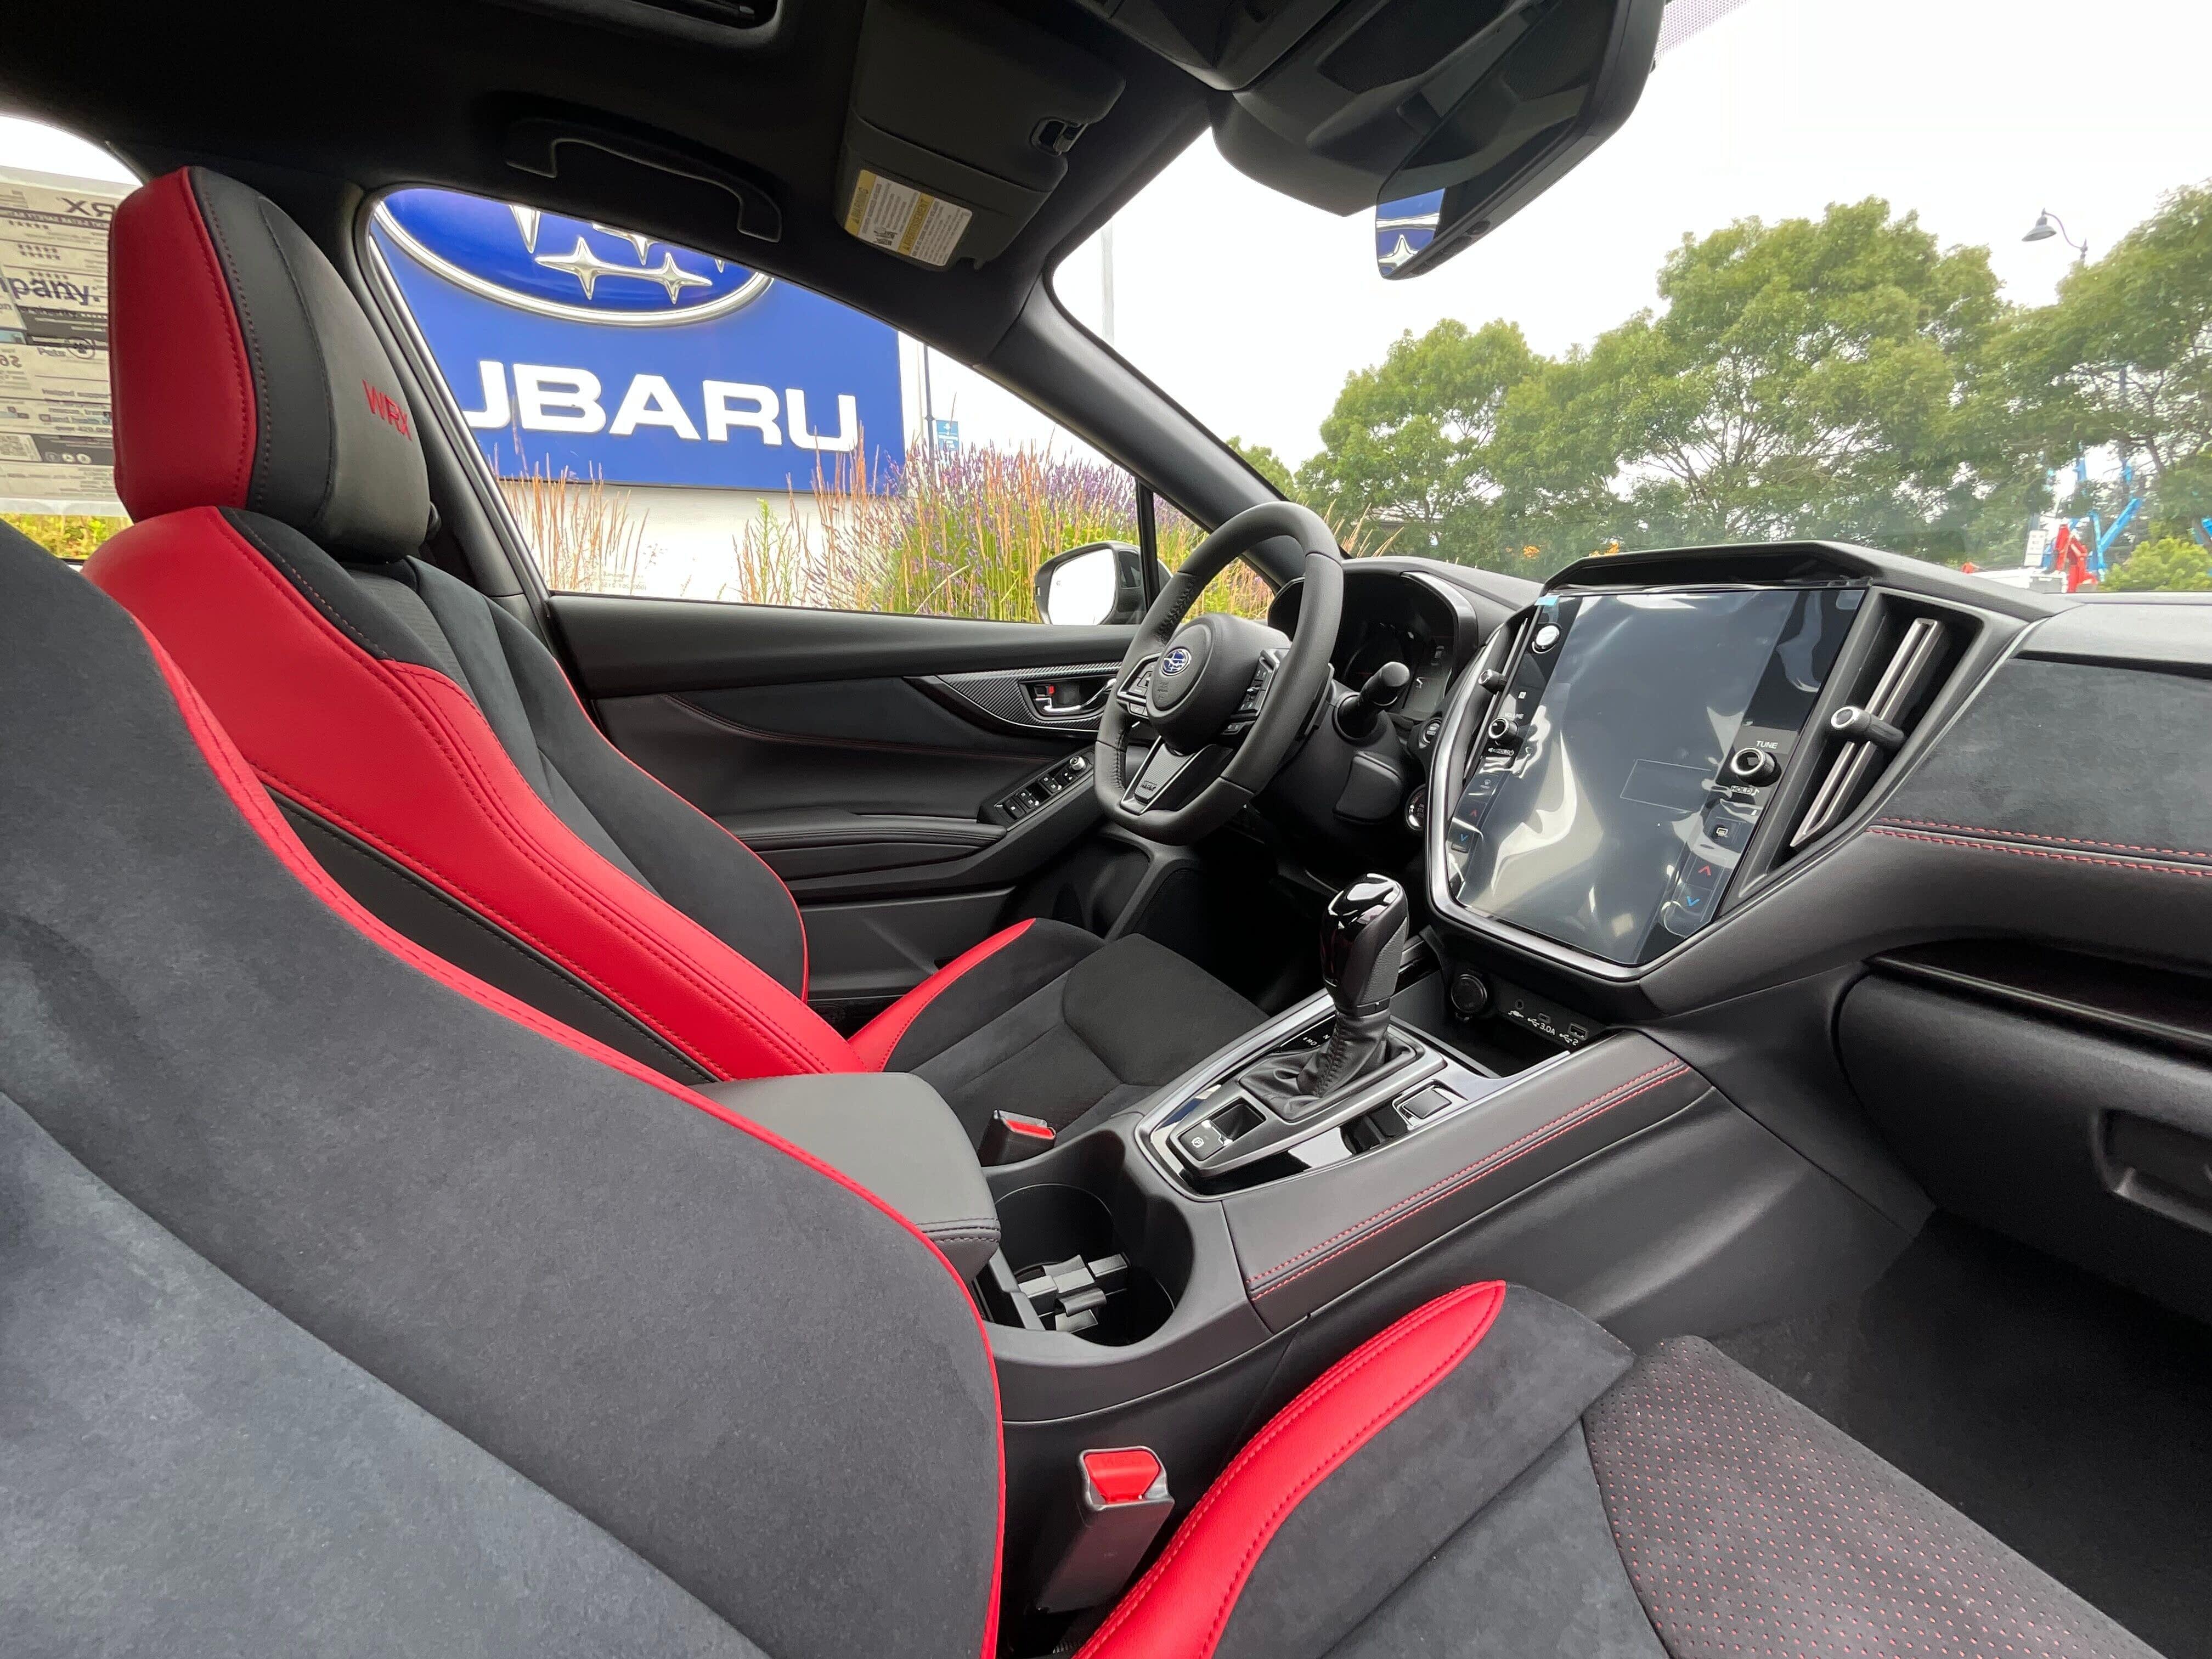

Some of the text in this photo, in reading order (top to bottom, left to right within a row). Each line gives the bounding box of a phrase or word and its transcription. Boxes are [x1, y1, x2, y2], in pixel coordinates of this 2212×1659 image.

[362, 379, 412, 441] WRX
[462, 360, 859, 452] UBARU
[1756, 741, 1779, 749] TUNE
[1731, 785, 1753, 795] HOLD
[1539, 1023, 1555, 1035] 3.0A
